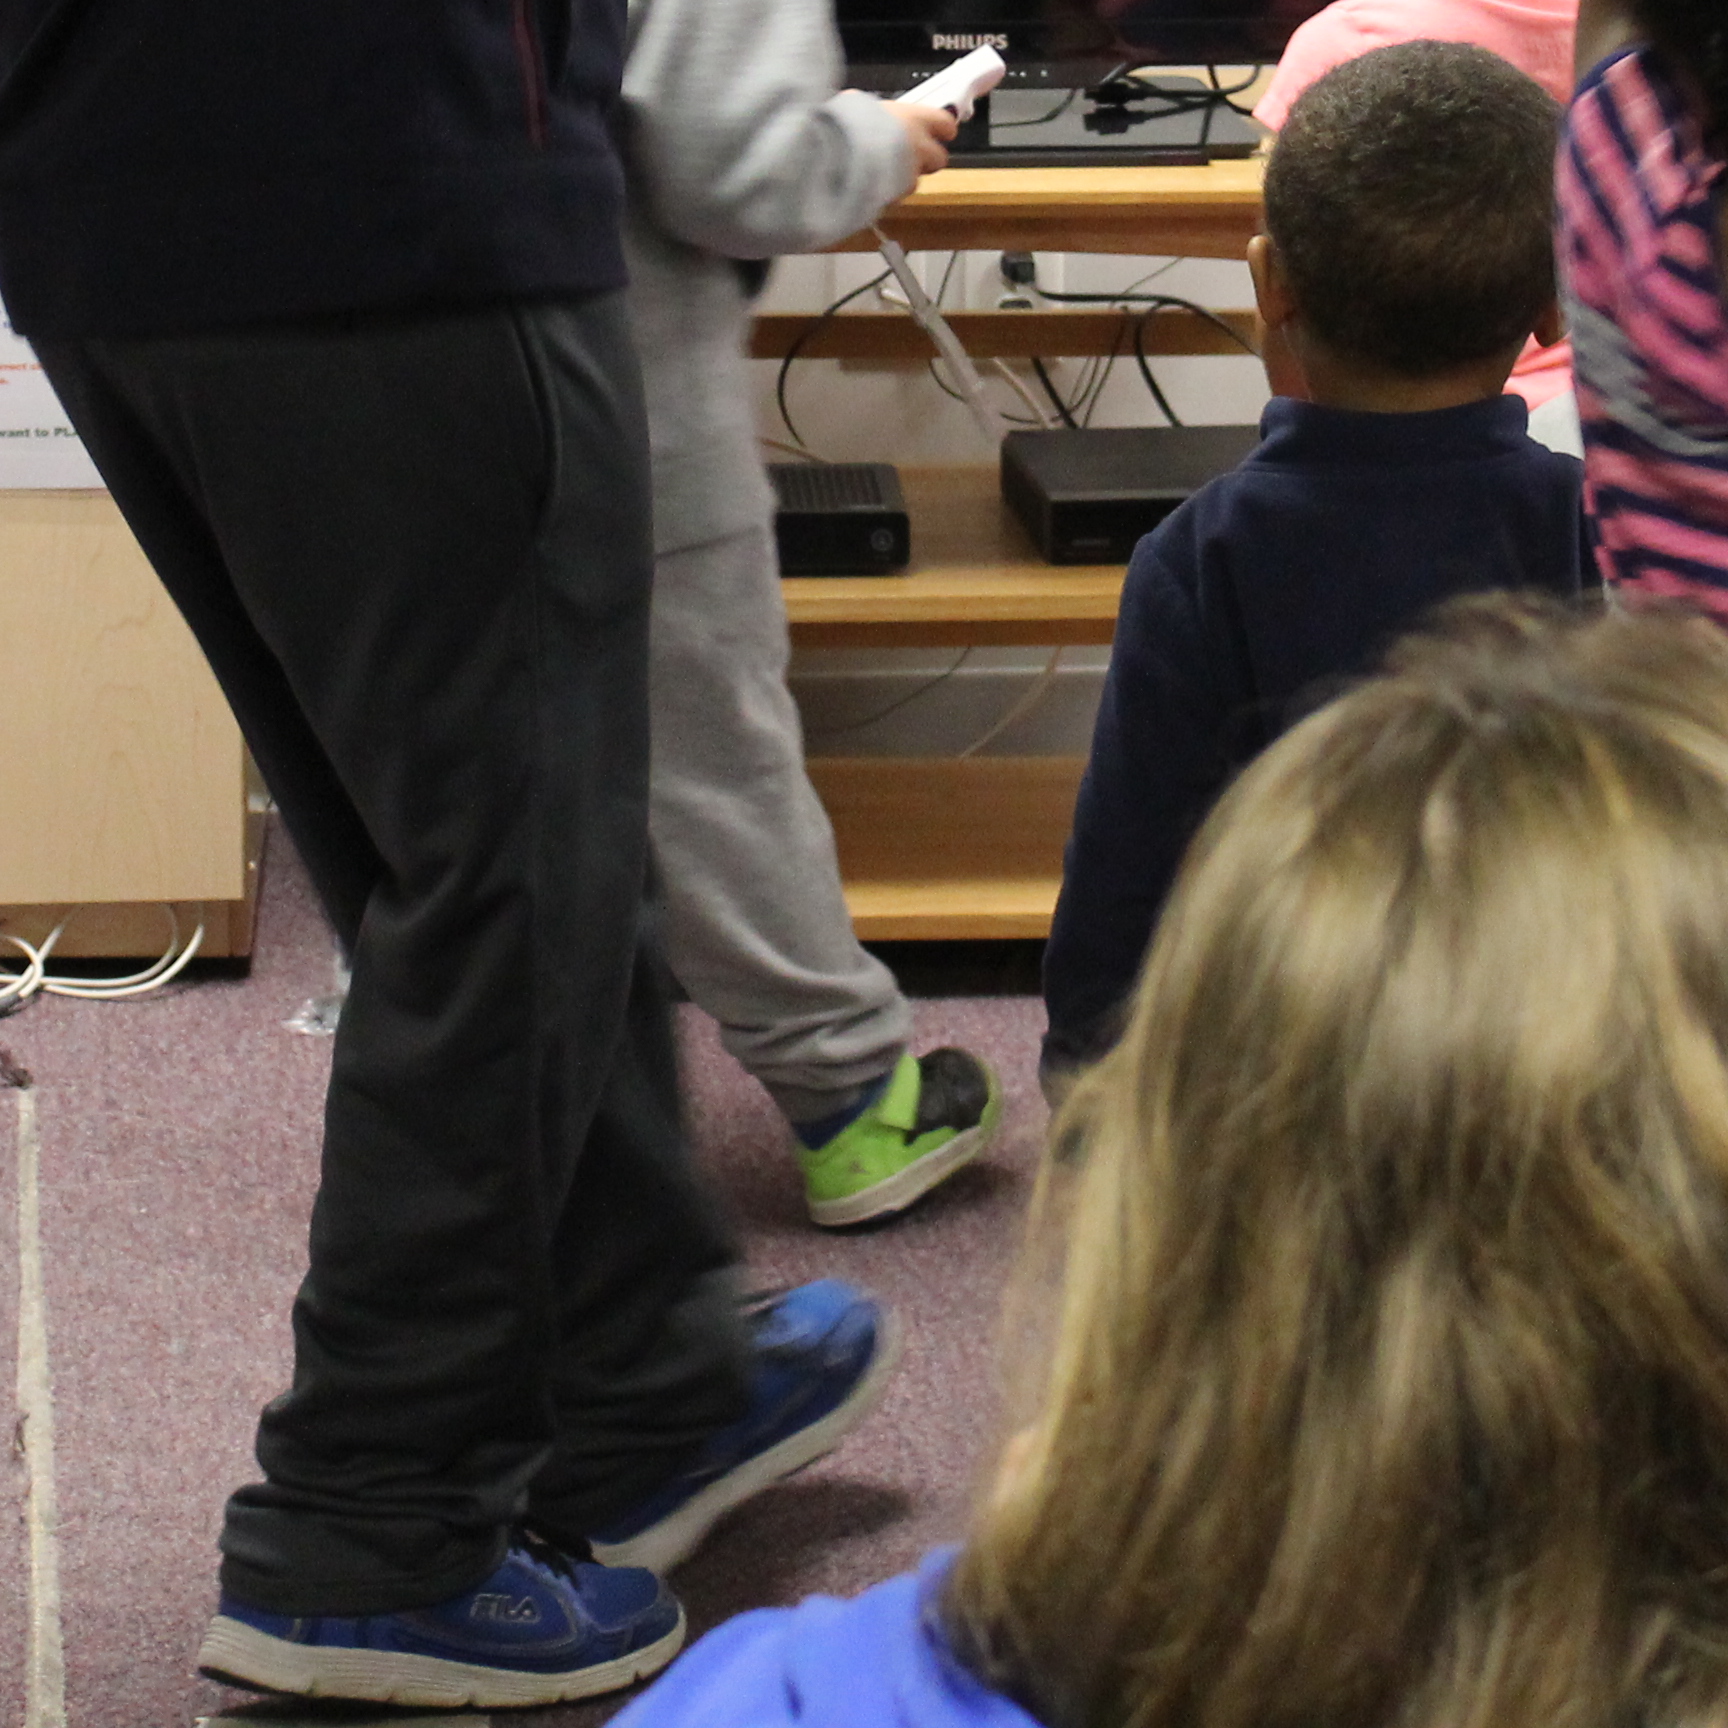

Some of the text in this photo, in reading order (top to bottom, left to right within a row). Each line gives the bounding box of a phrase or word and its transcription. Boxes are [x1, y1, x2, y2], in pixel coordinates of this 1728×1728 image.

[932, 33, 1009, 51] PHILIPS
[34, 426, 50, 438] to
[469, 1593, 541, 1624] FILA
